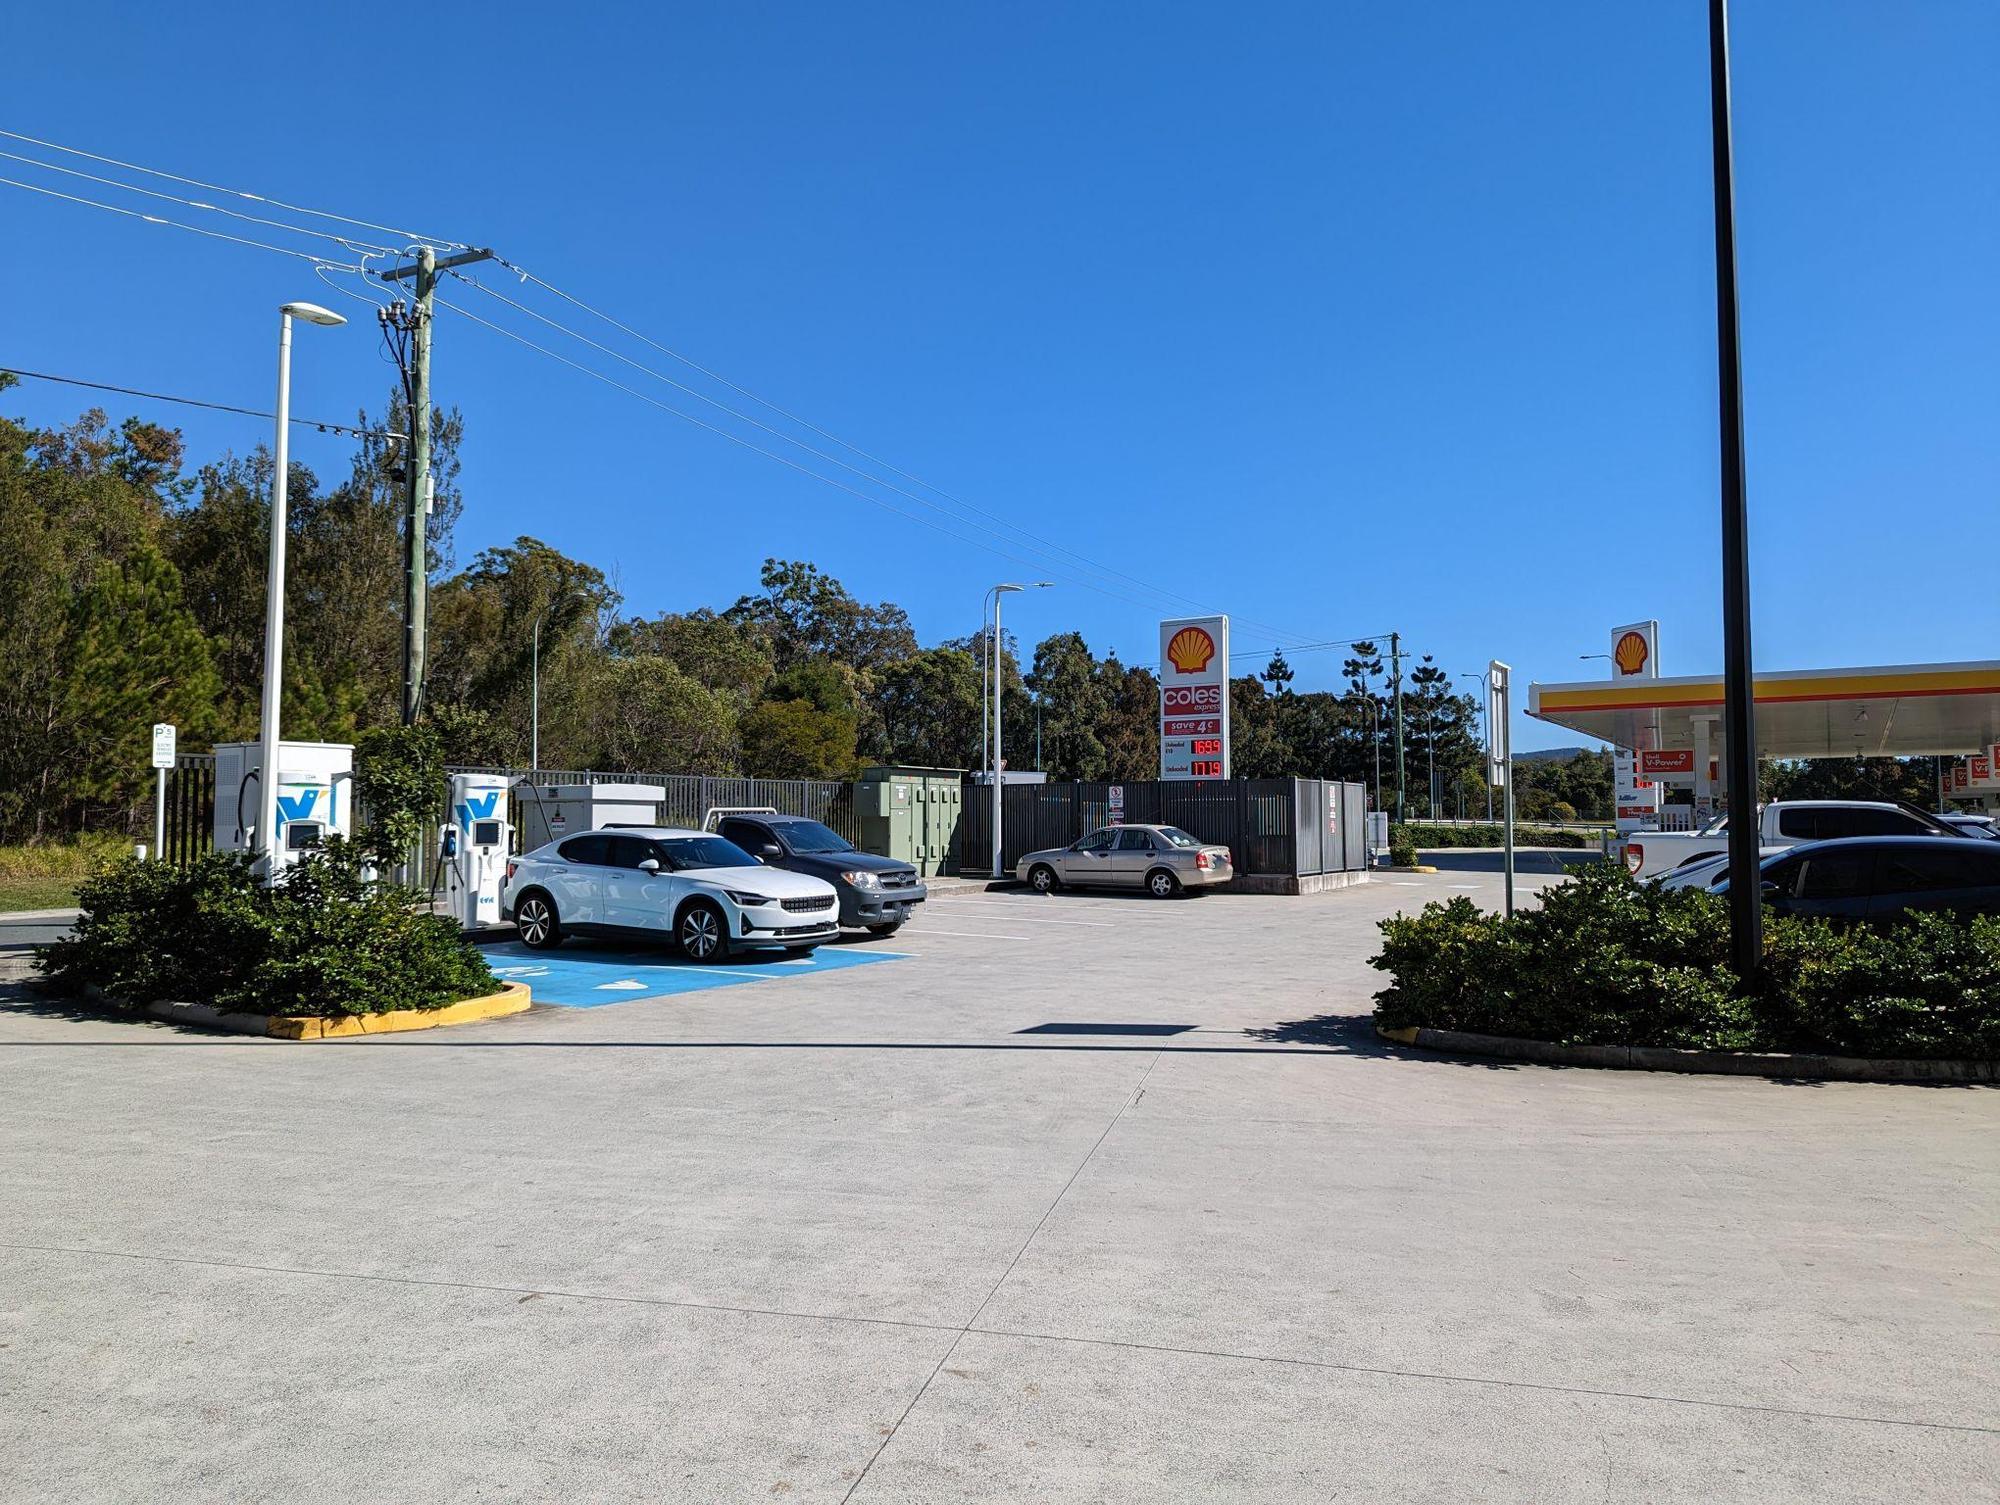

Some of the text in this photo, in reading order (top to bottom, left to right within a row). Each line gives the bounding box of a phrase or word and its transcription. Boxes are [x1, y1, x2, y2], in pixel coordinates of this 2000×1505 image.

[1164, 686, 1220, 705] coles
[1171, 721, 1195, 730] save
[155, 728, 164, 738] P
[1646, 759, 1682, 767] V-Power
